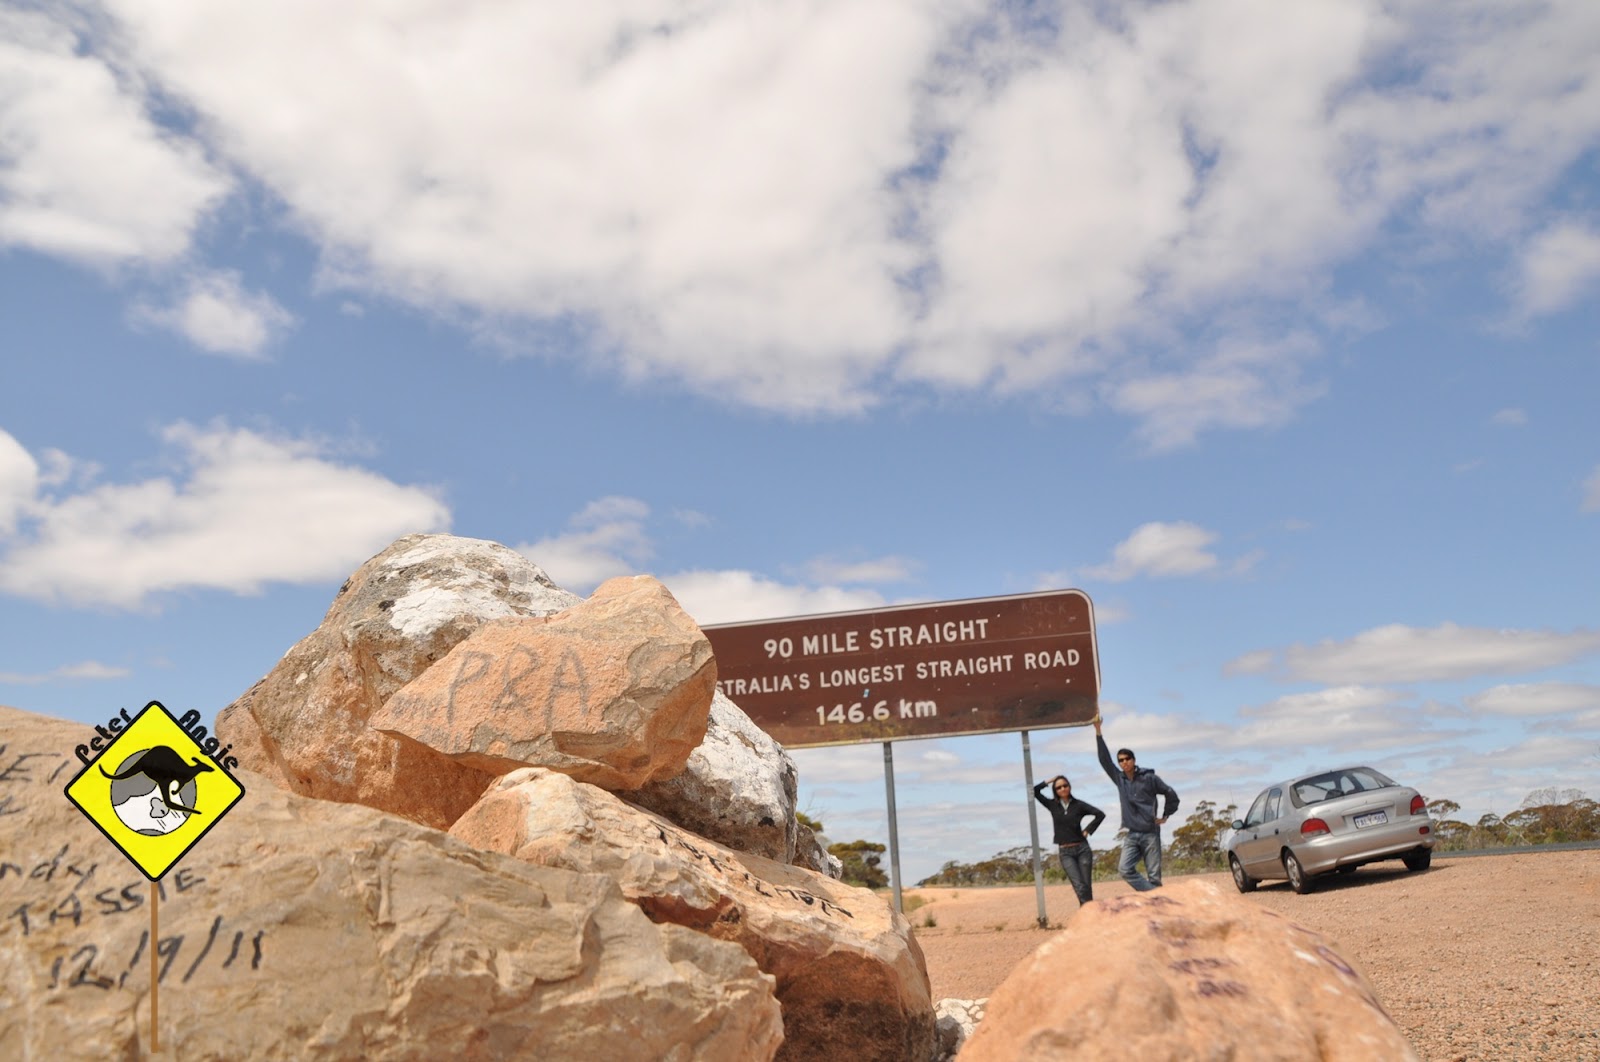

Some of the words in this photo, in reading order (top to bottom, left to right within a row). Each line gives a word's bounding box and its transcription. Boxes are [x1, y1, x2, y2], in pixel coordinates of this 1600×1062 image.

[763, 637, 793, 659] 90
[802, 631, 860, 656] MILE
[869, 618, 989, 650] STRAIGHT
[819, 664, 905, 689] LONGEST
[916, 654, 1014, 680] STRAIGHT
[1024, 648, 1080, 670] ROAD
[816, 699, 890, 726] 146.6
[898, 697, 937, 719] km
[7, 867, 205, 936] TASSIE
